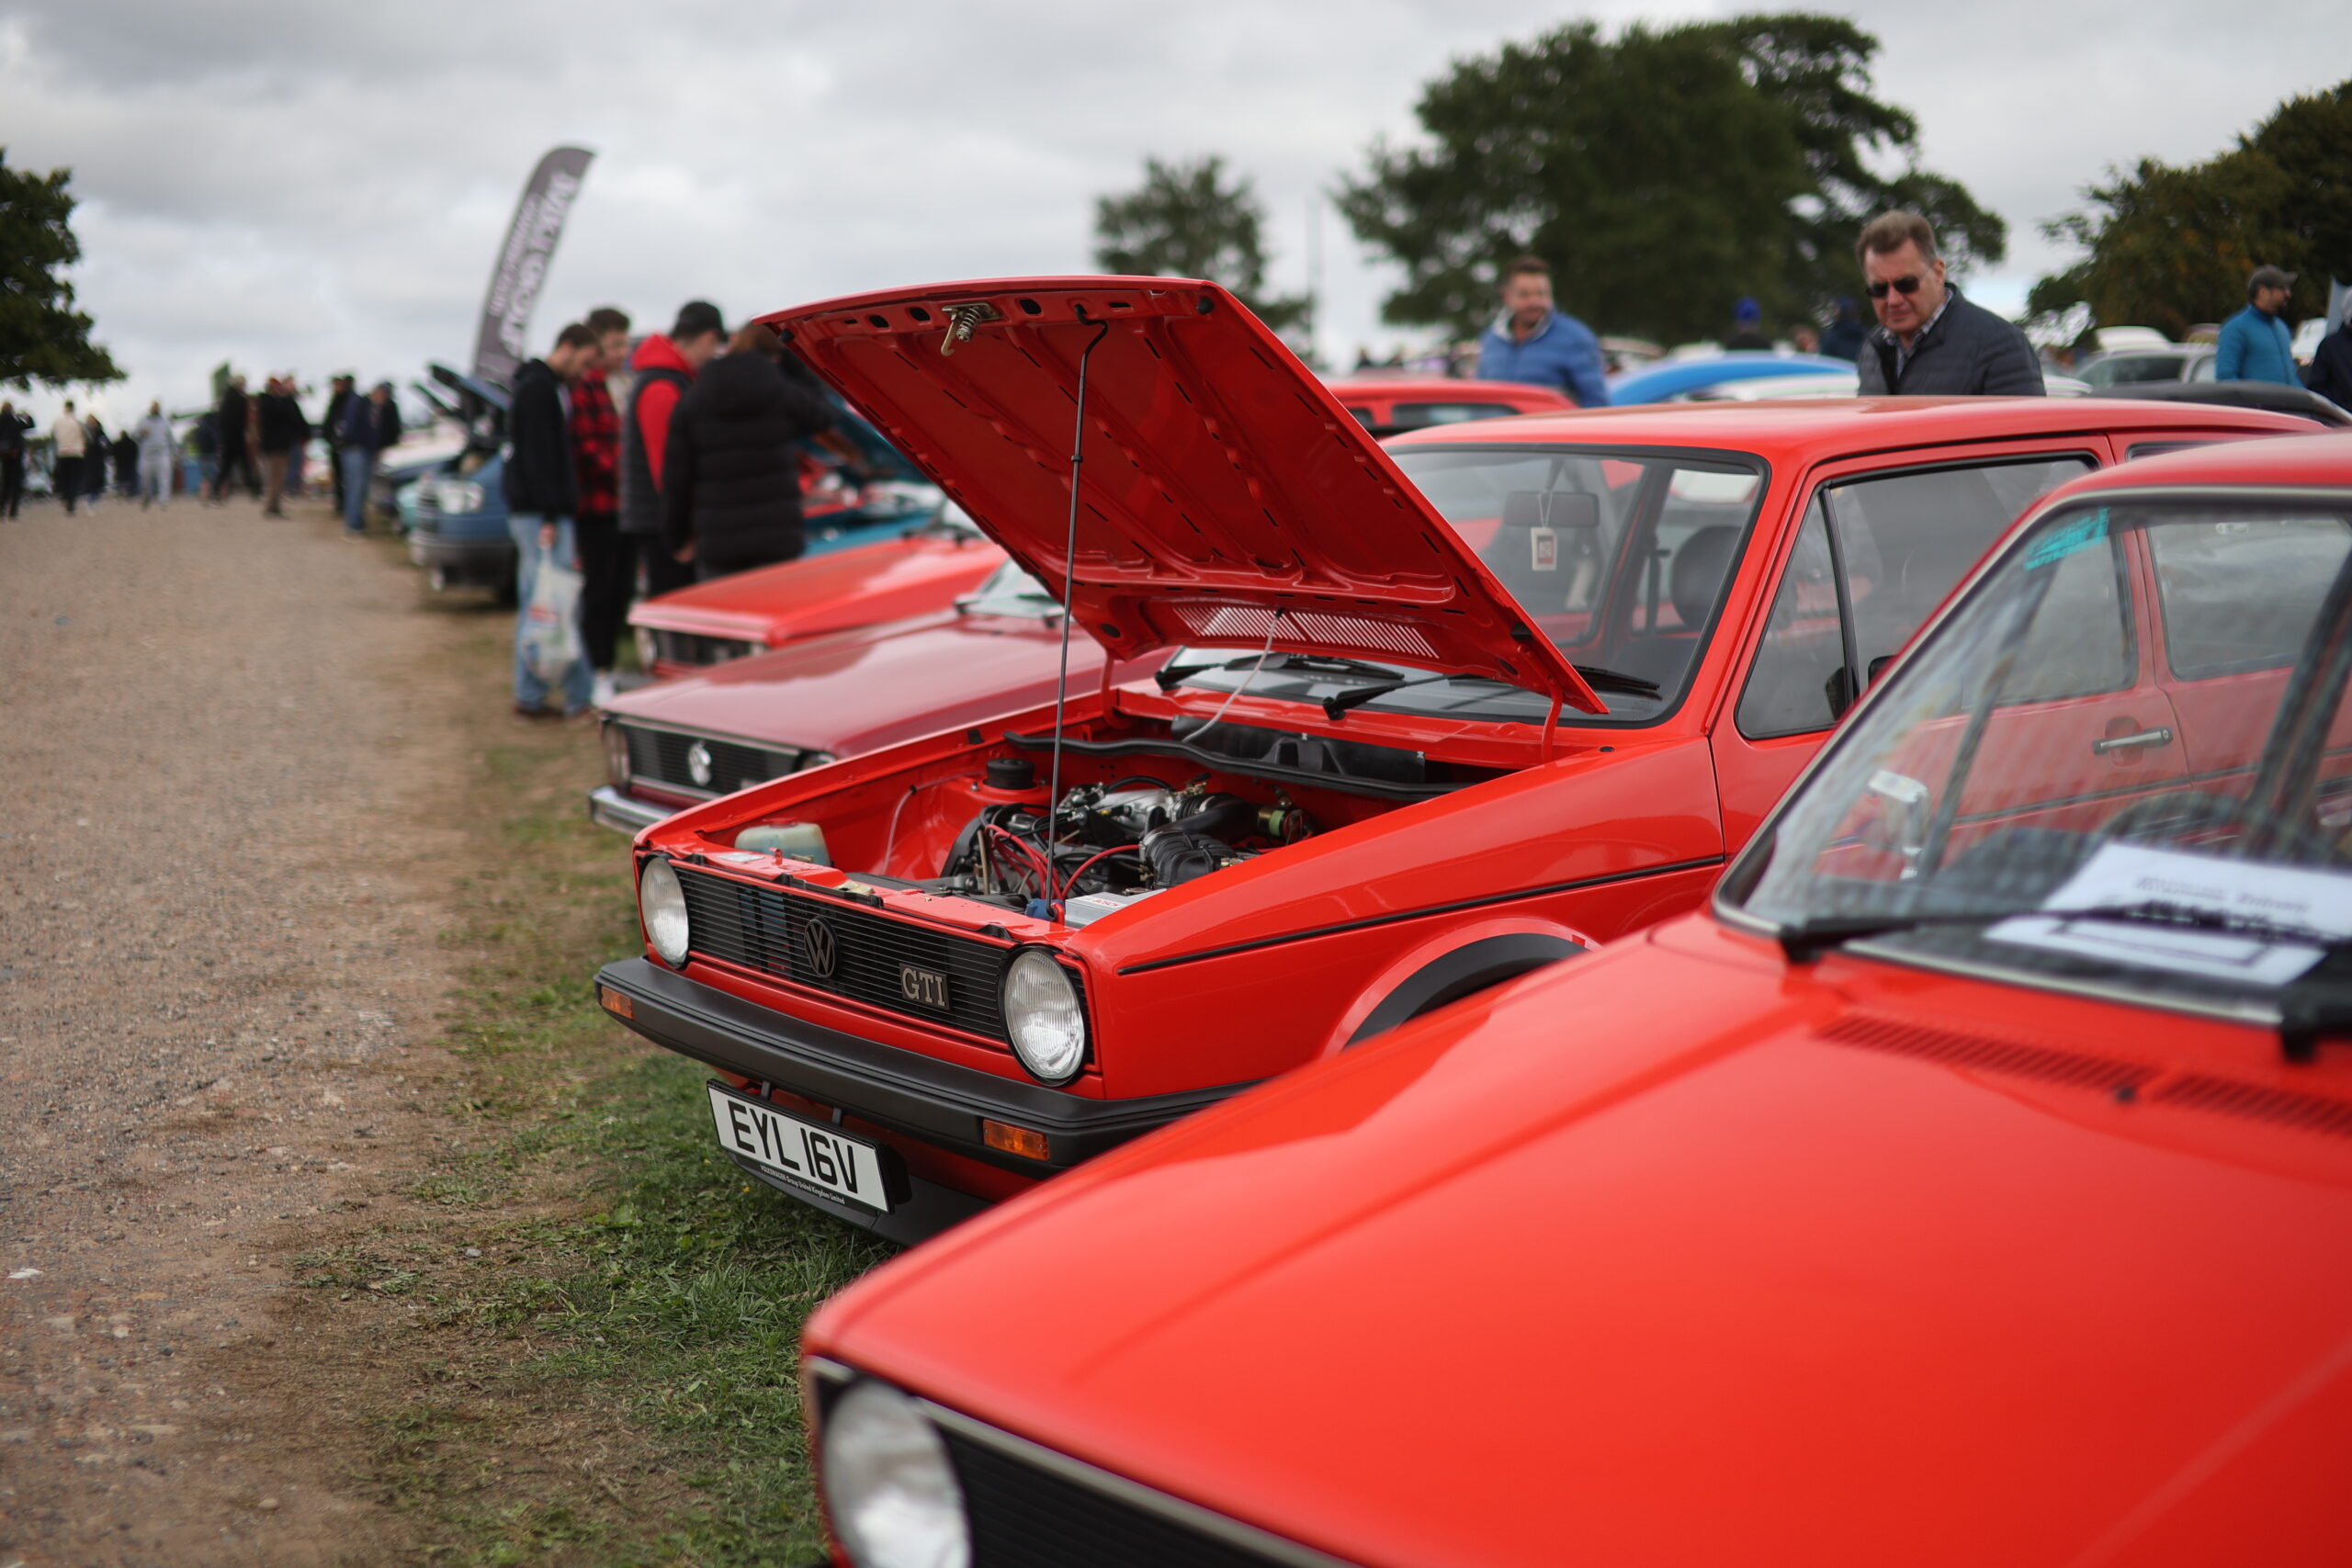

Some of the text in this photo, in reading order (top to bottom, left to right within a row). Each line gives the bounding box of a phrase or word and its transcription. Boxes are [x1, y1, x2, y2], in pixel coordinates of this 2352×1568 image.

[804, 919, 836, 978] VW
[901, 966, 945, 1007] GTI
[728, 1100, 859, 1194] EYL 16V
[760, 1164, 845, 1204] VOLKSWAGEN Group United Kingdom Limited
